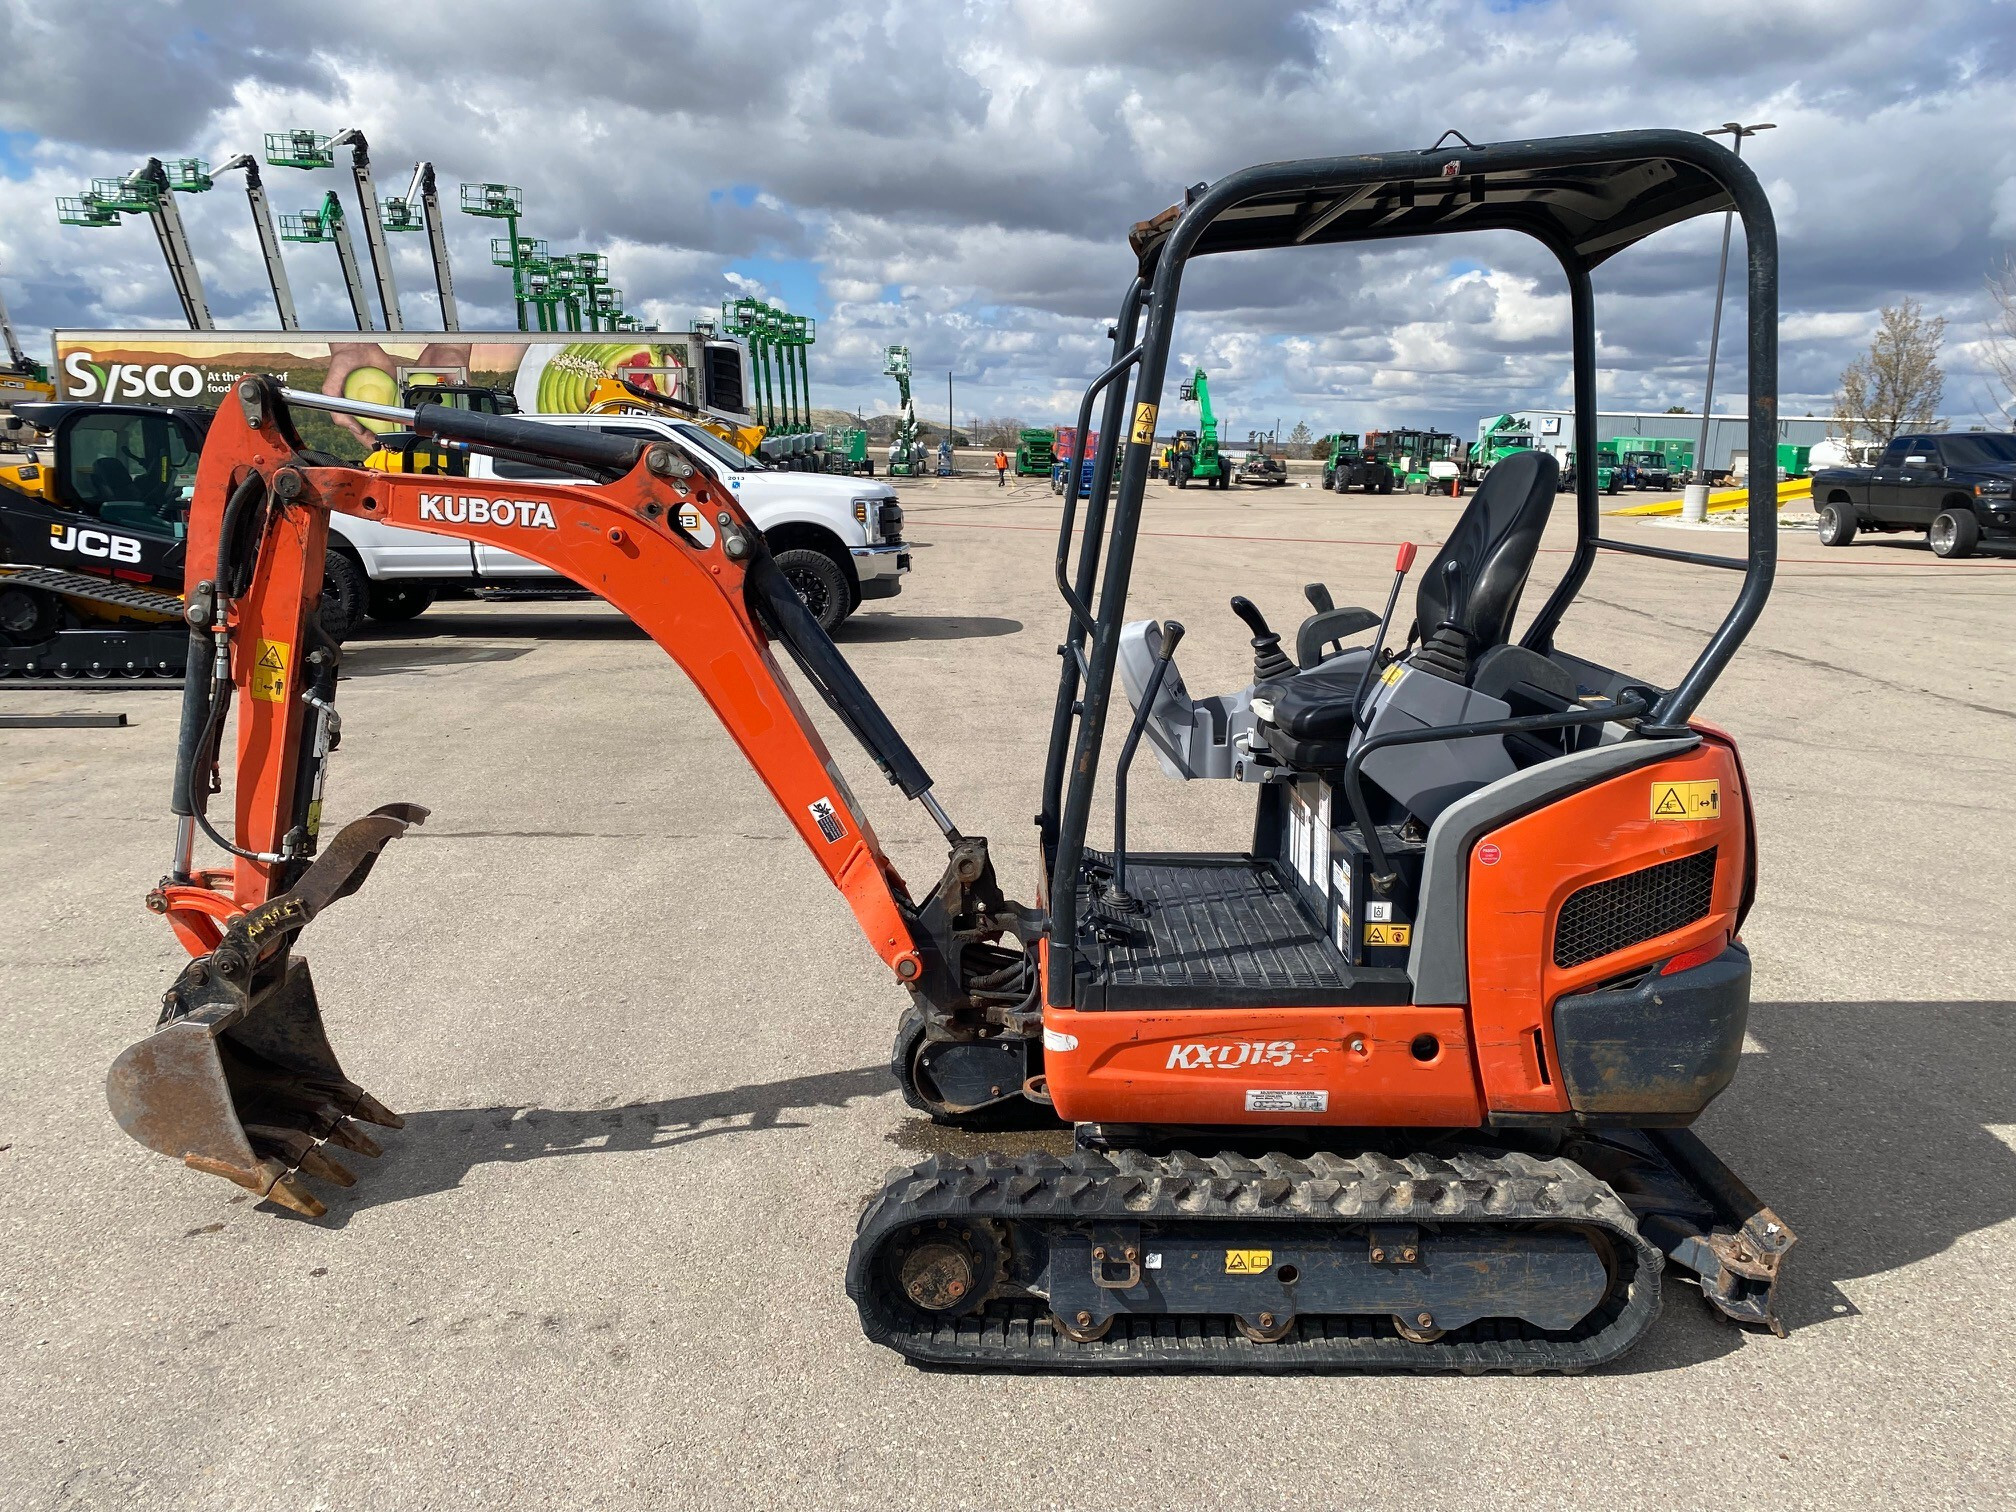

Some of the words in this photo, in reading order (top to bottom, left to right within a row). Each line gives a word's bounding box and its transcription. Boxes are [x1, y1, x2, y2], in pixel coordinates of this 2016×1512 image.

[207, 371, 221, 382] At
[222, 371, 240, 382] the
[276, 371, 288, 382] of
[0, 380, 25, 389] JCB
[207, 383, 232, 393] food
[420, 494, 557, 529] KUBOTA
[50, 526, 142, 564] JCB
